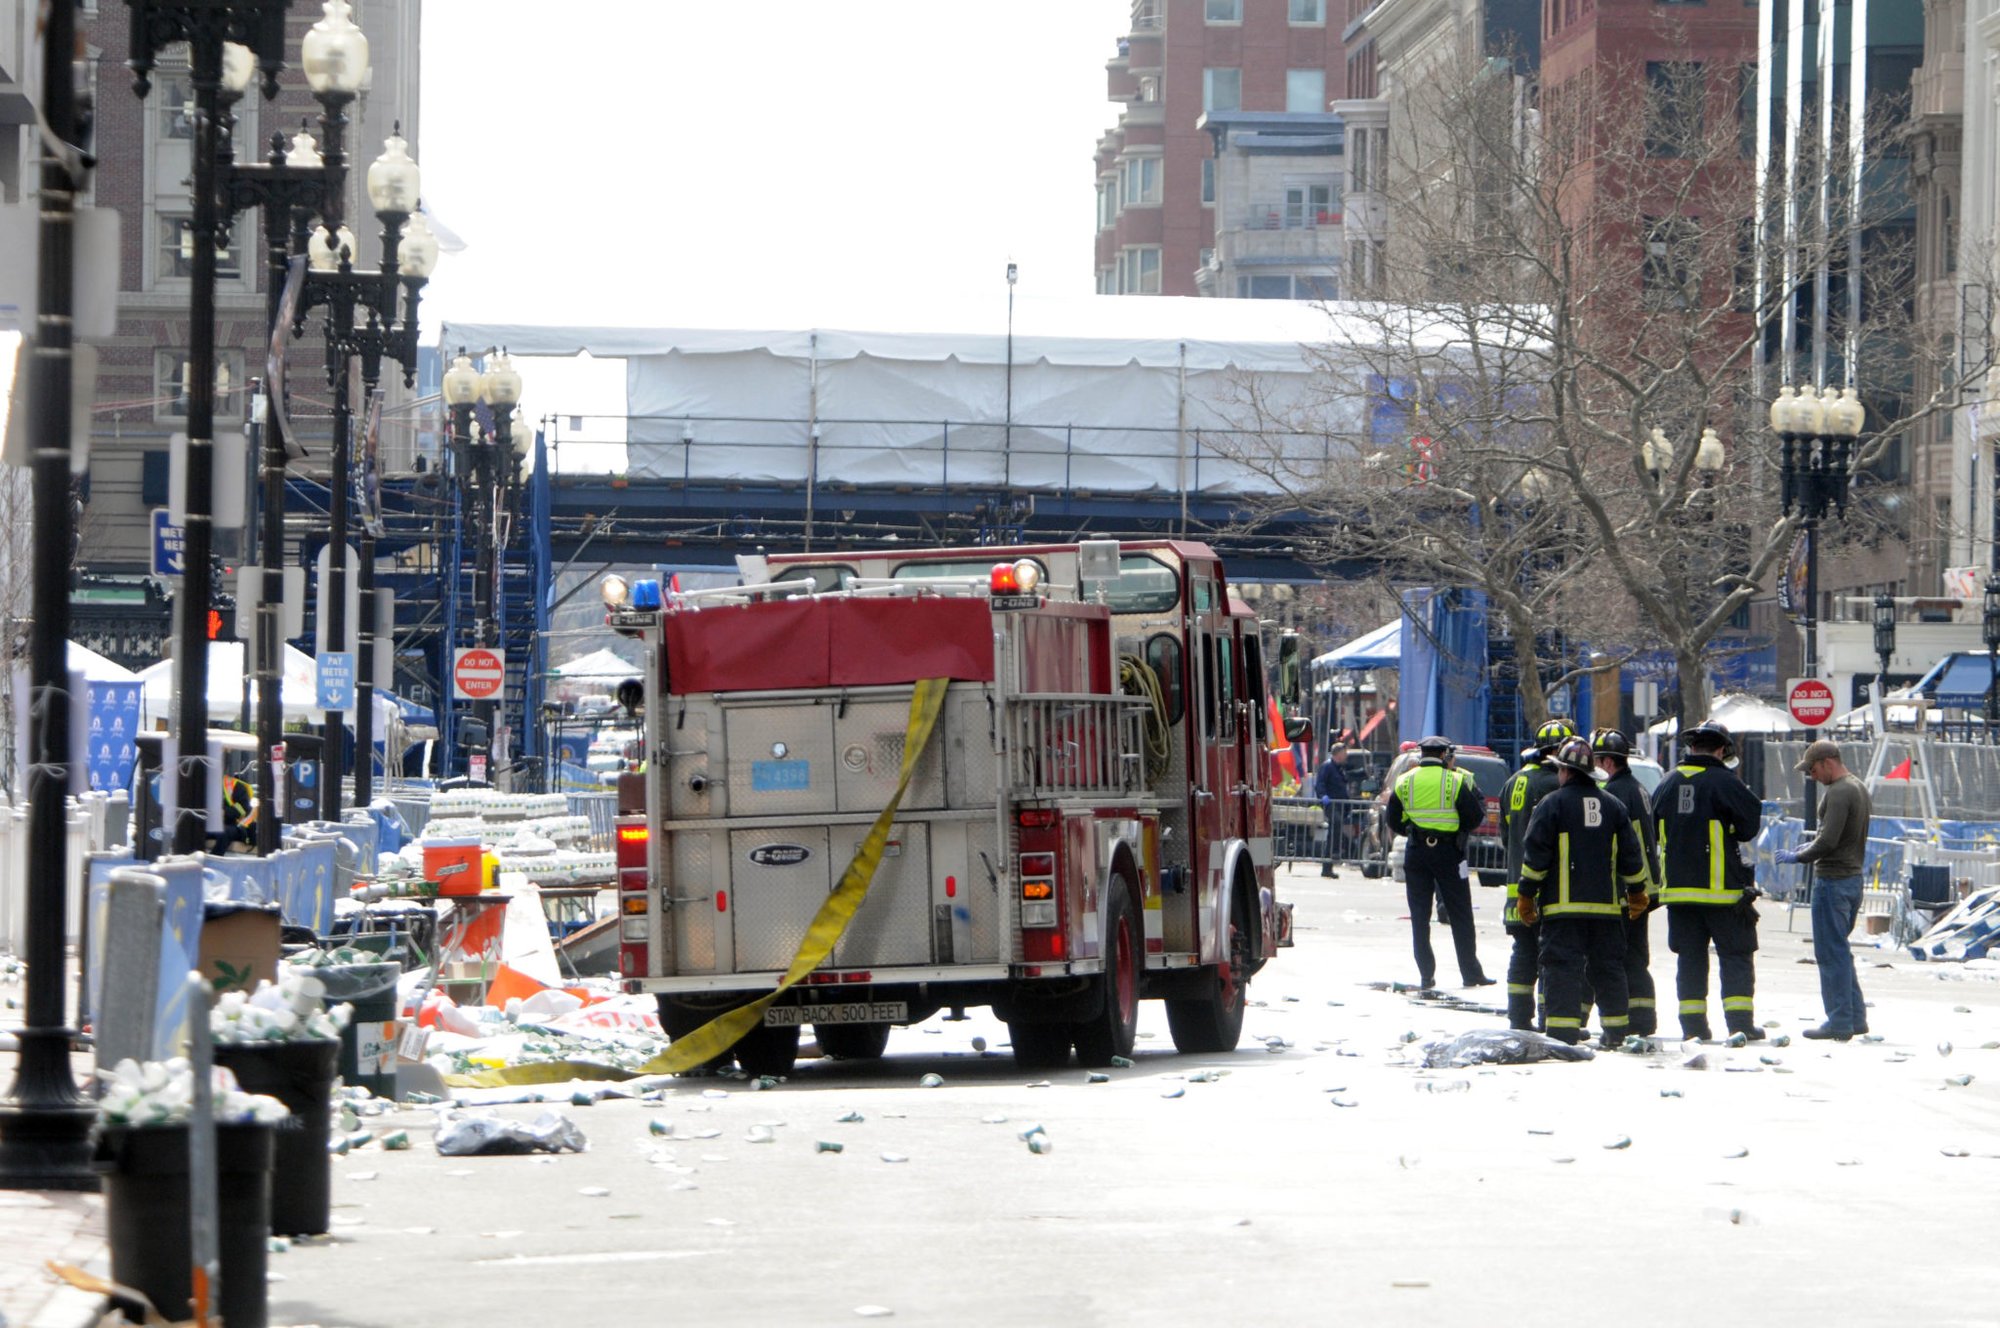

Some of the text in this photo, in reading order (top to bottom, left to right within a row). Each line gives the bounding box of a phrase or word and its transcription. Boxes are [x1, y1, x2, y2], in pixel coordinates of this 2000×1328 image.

[160, 527, 185, 538] MET
[994, 598, 1034, 608] E-ONE
[612, 614, 653, 625] E-ONE
[327, 656, 343, 665] PAY
[464, 658, 494, 667] DO NOT
[321, 667, 349, 677] METER
[324, 678, 345, 688] HERE
[465, 680, 492, 689] ENTER
[1795, 690, 1807, 698] DO
[1799, 708, 1825, 716] ENTER
[299, 763, 312, 783] P
[754, 848, 803, 861] E-ONE
[767, 1003, 902, 1024] STAY BACK 500 FEET
